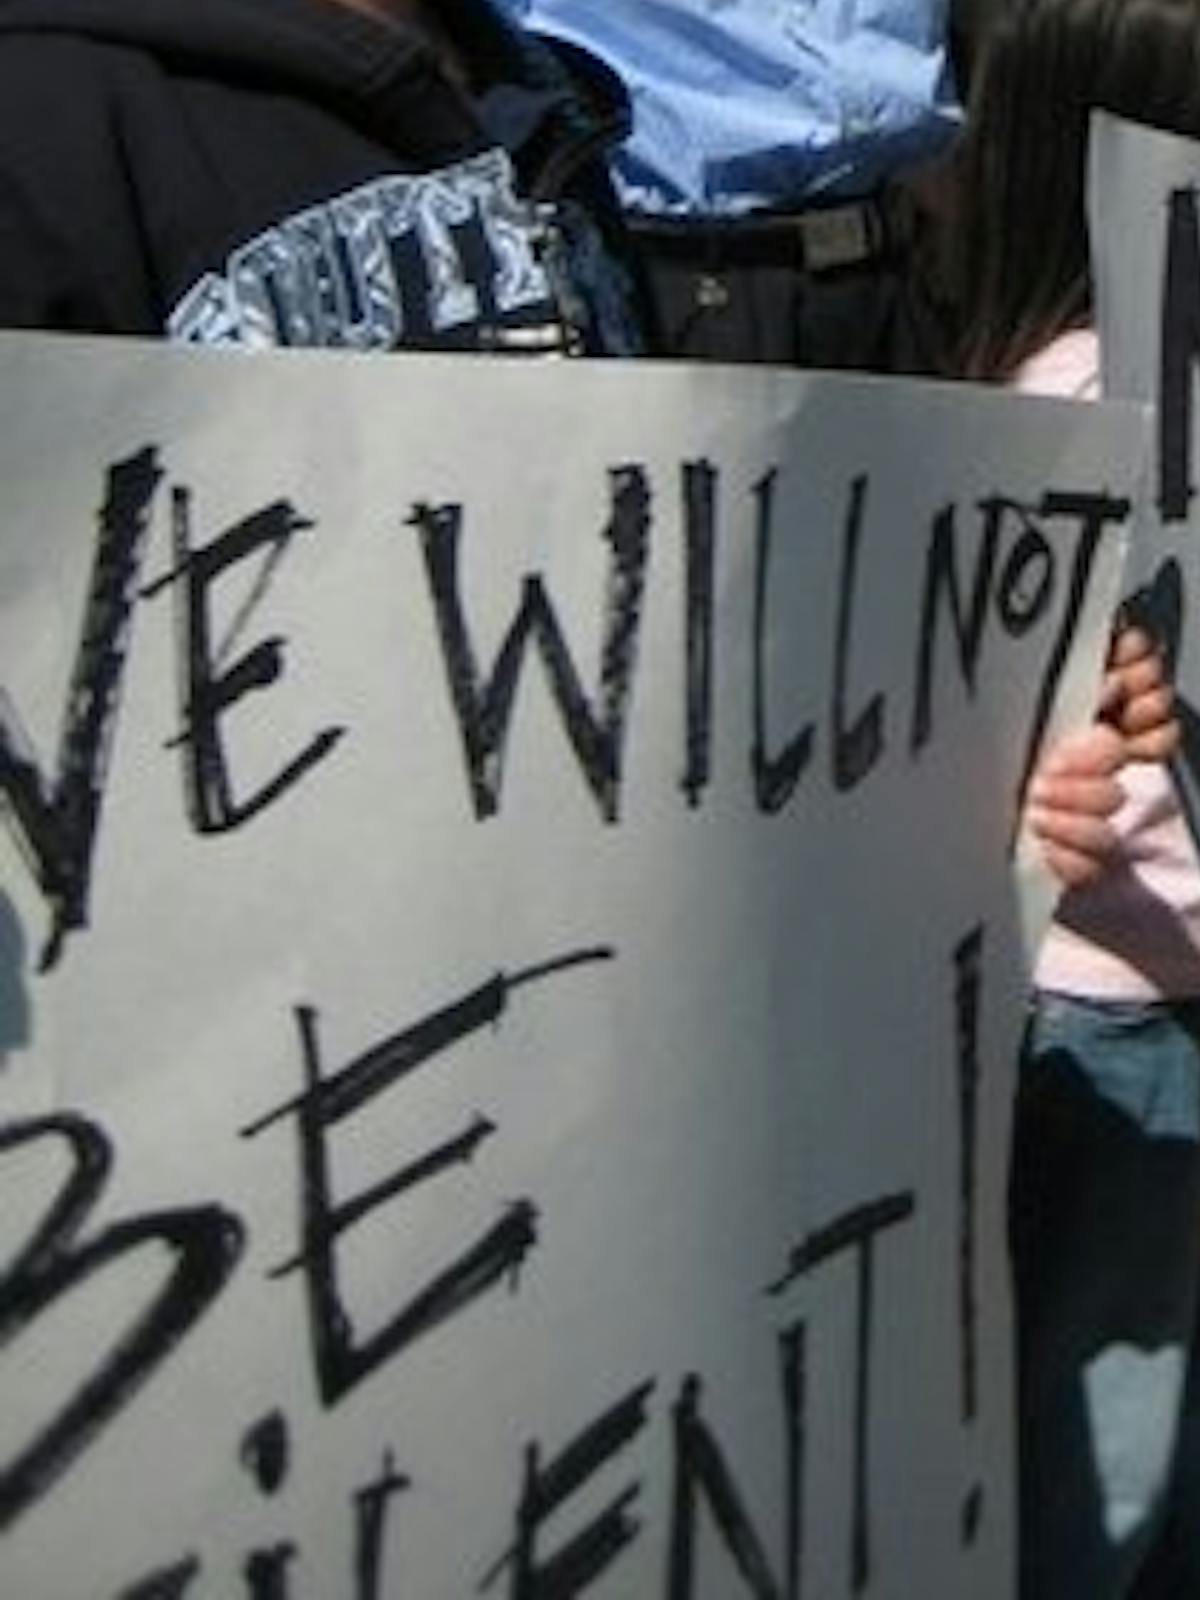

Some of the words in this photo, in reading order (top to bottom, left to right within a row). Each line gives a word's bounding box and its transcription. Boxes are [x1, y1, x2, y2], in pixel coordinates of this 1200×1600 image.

[405, 457, 886, 826] WILL
[908, 490, 1130, 862] NOT
[0, 945, 616, 1535] BE
[112, 920, 986, 1600] iENT!
